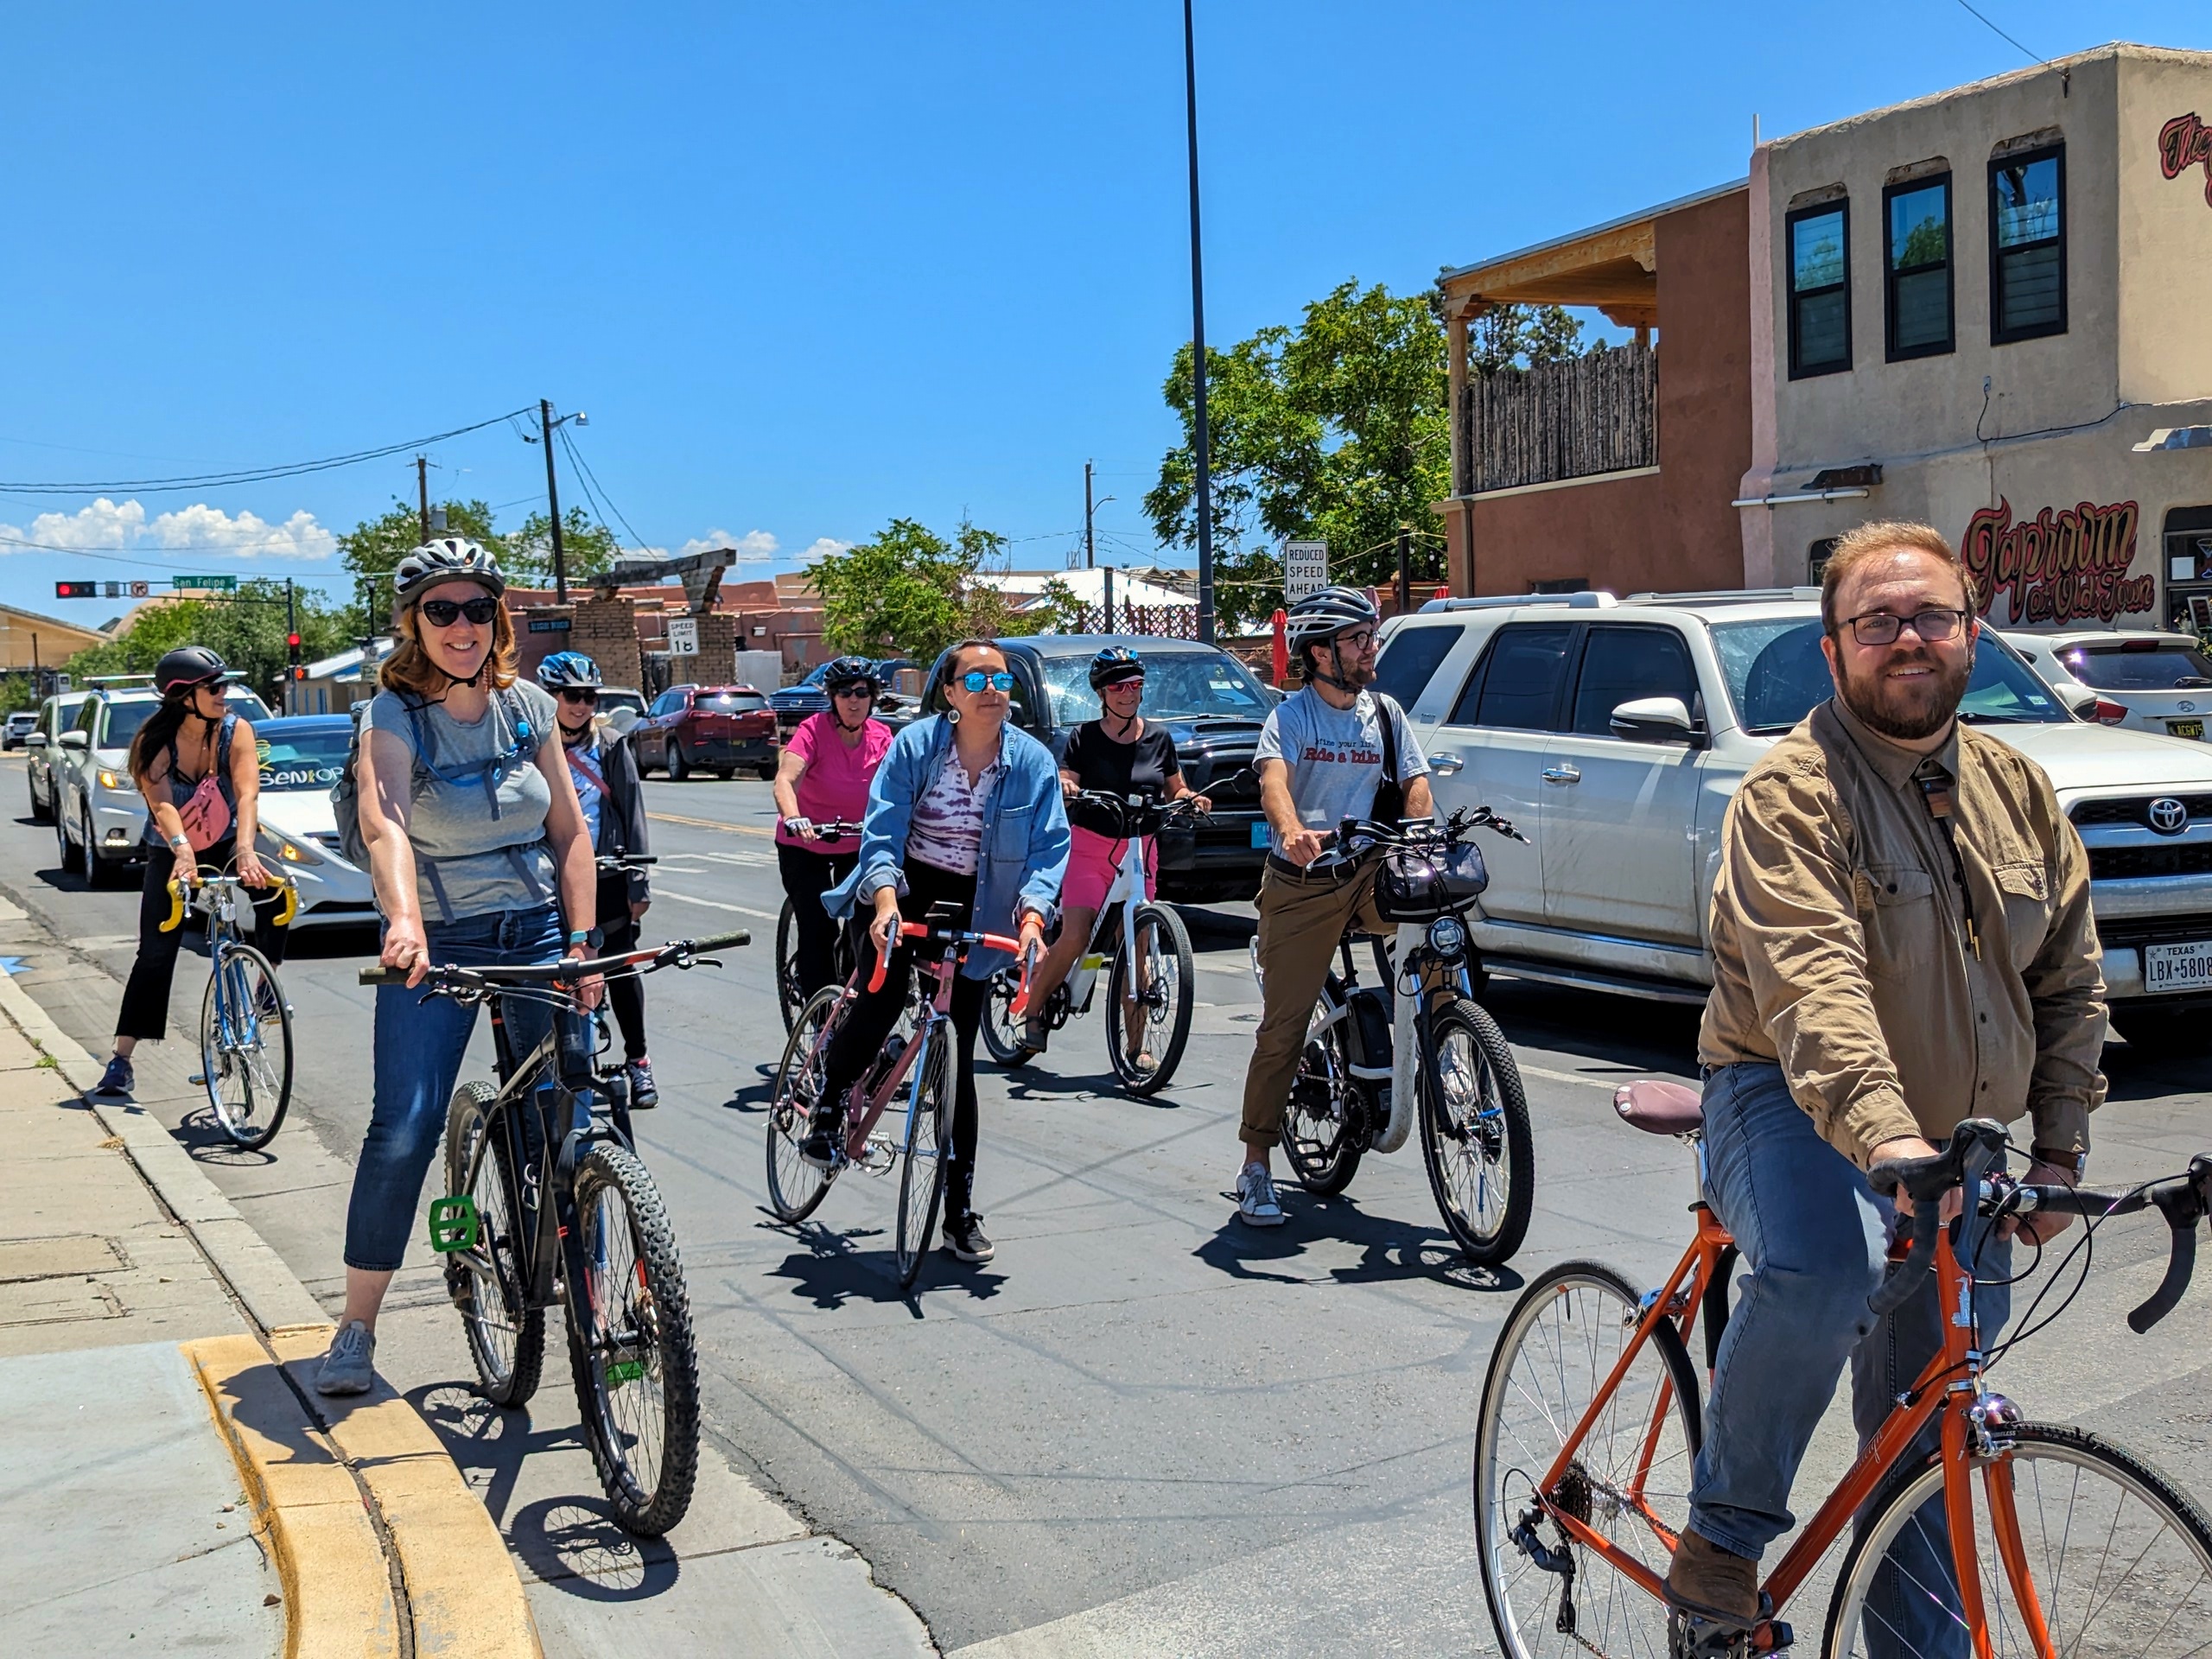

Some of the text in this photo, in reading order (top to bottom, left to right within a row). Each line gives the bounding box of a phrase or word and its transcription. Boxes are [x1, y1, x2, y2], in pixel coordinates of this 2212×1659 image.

[1289, 550, 1324, 561] REDUCED
[1962, 496, 2139, 620] Taproom
[1289, 566, 1323, 578] SPEED
[174, 577, 191, 588] San
[197, 577, 226, 588] Felipe
[1289, 583, 1324, 594] AHEAD
[2027, 583, 2052, 620] at
[2053, 572, 2097, 621] Old
[2097, 569, 2153, 619] Town
[1303, 747, 1335, 763] Rde
[1338, 752, 1347, 763] a
[2167, 945, 2196, 957] TEXAS
